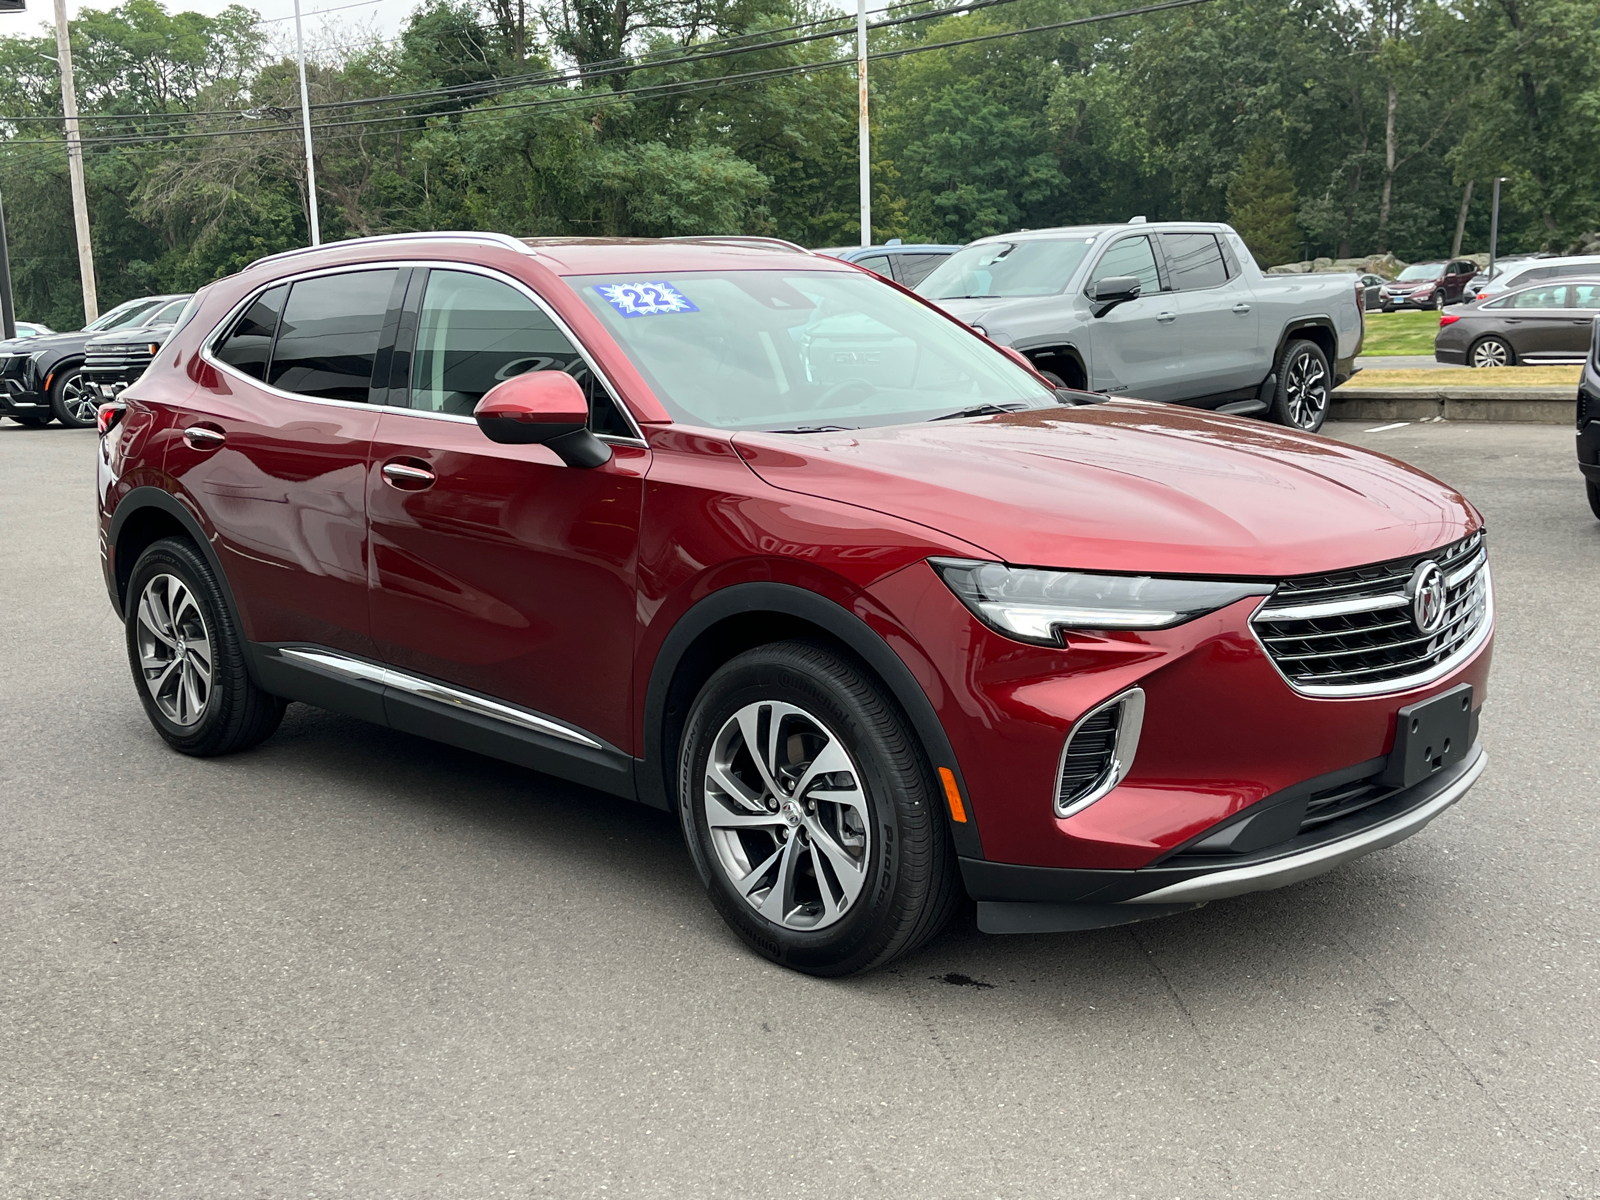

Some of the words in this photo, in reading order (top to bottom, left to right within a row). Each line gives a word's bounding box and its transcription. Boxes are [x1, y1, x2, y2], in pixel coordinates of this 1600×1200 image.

[622, 287, 671, 308] 22
[834, 351, 881, 363] GMC
[777, 670, 850, 724] Continental
